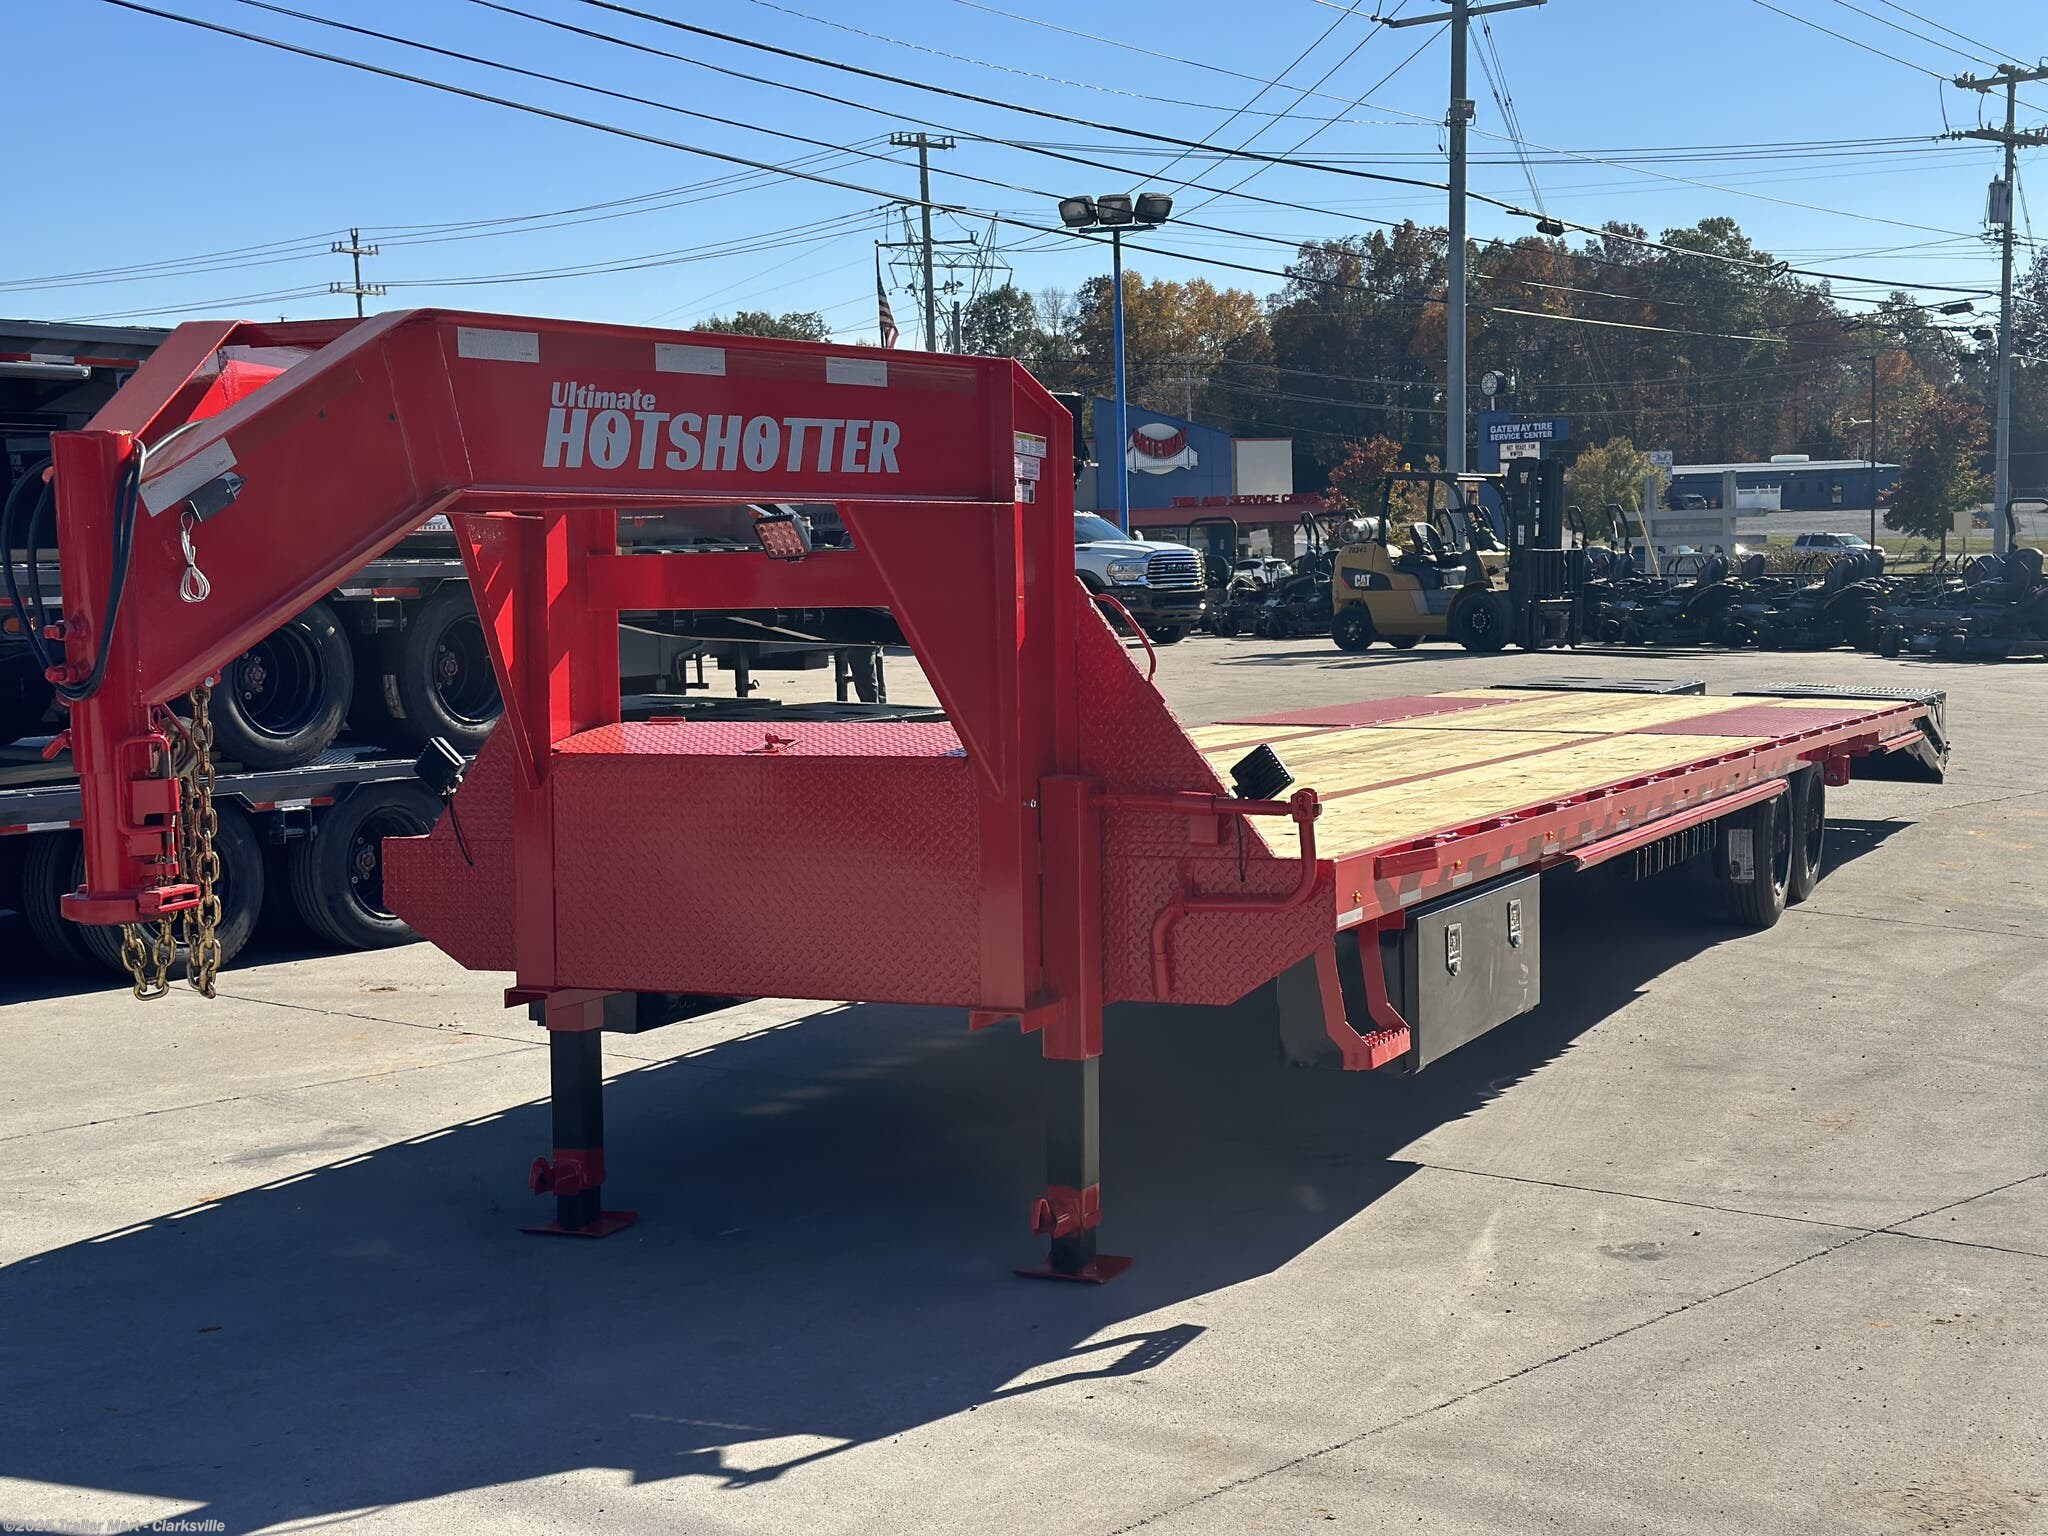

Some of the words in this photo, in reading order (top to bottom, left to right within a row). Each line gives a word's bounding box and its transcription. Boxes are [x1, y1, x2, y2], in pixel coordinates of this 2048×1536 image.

[551, 381, 656, 411] Ultimate
[1490, 423, 1533, 433] GATEWAY
[1533, 422, 1553, 430] TIRE
[542, 407, 901, 473] HOTSHOTTER
[1490, 433, 1520, 441] SERVICE
[1523, 430, 1553, 438] CENTER
[1229, 494, 1279, 506] SERVICE
[1354, 574, 1371, 587] CAT
